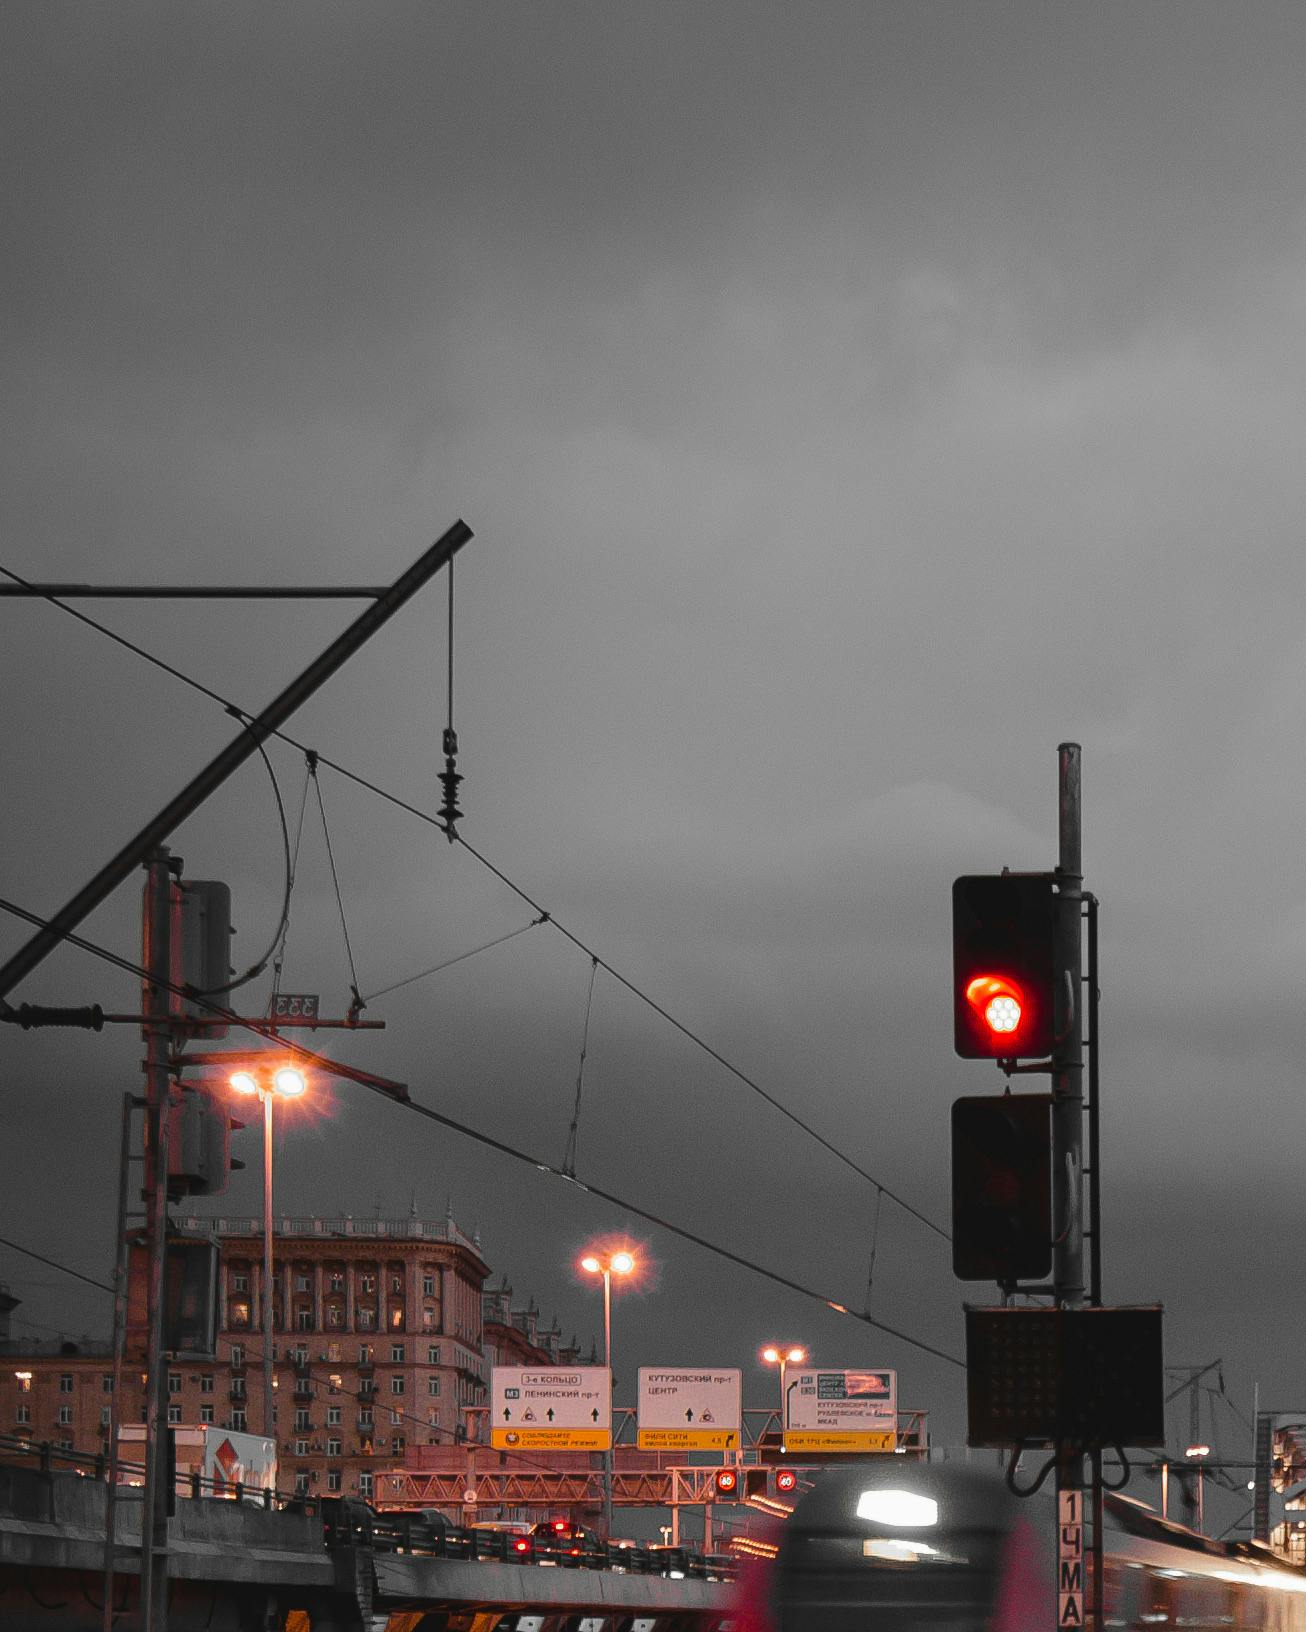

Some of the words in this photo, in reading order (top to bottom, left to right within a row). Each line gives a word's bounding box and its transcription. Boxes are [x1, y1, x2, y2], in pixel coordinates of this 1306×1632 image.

[540, 1376, 578, 1385] КОЛЬЦО
[648, 1374, 712, 1383] КУТУЗОВСКИЙ
[714, 1376, 732, 1384] пр-т
[525, 1389, 580, 1398] ЛЕНИНСКИЙ
[648, 1387, 678, 1395] ЦЕНТР
